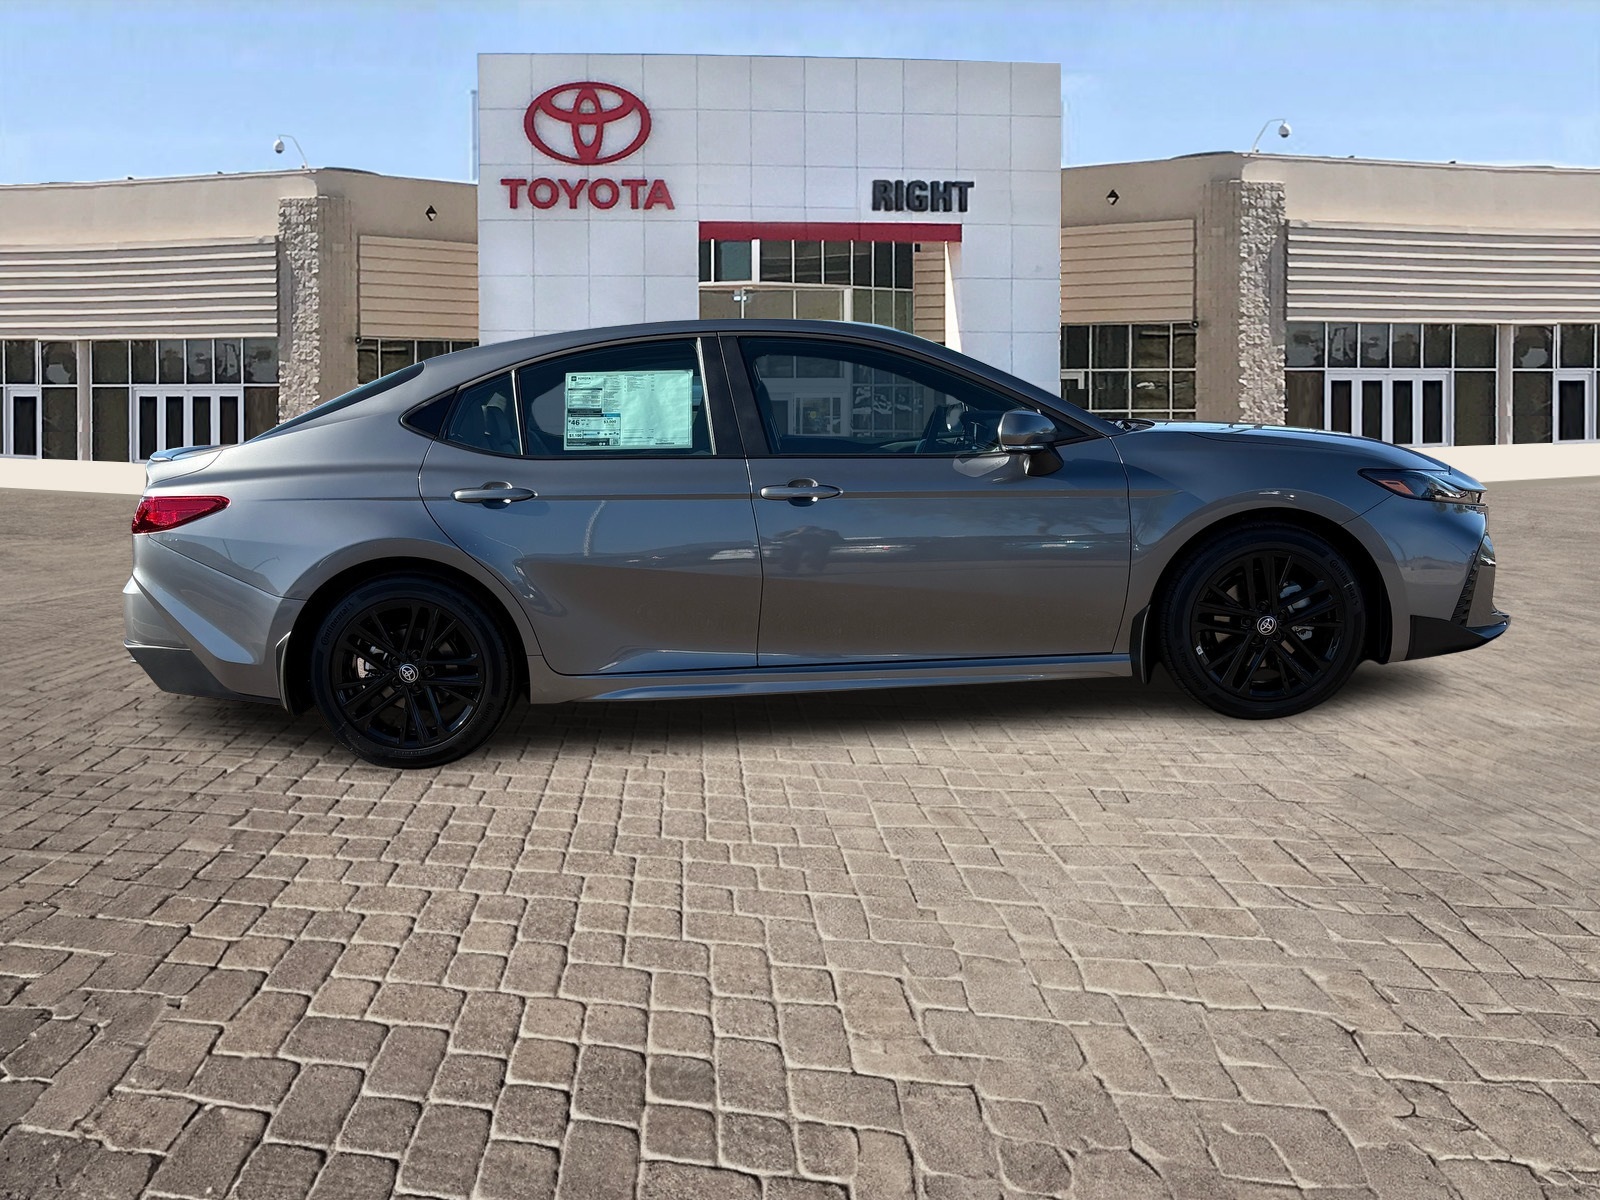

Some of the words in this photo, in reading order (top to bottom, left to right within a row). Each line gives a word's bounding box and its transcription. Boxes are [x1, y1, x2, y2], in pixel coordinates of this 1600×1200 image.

[500, 178, 675, 210] TOYOTA
[872, 179, 975, 212] RIGHT
[1329, 559, 1358, 601] Continental
[320, 605, 350, 646] Continental
